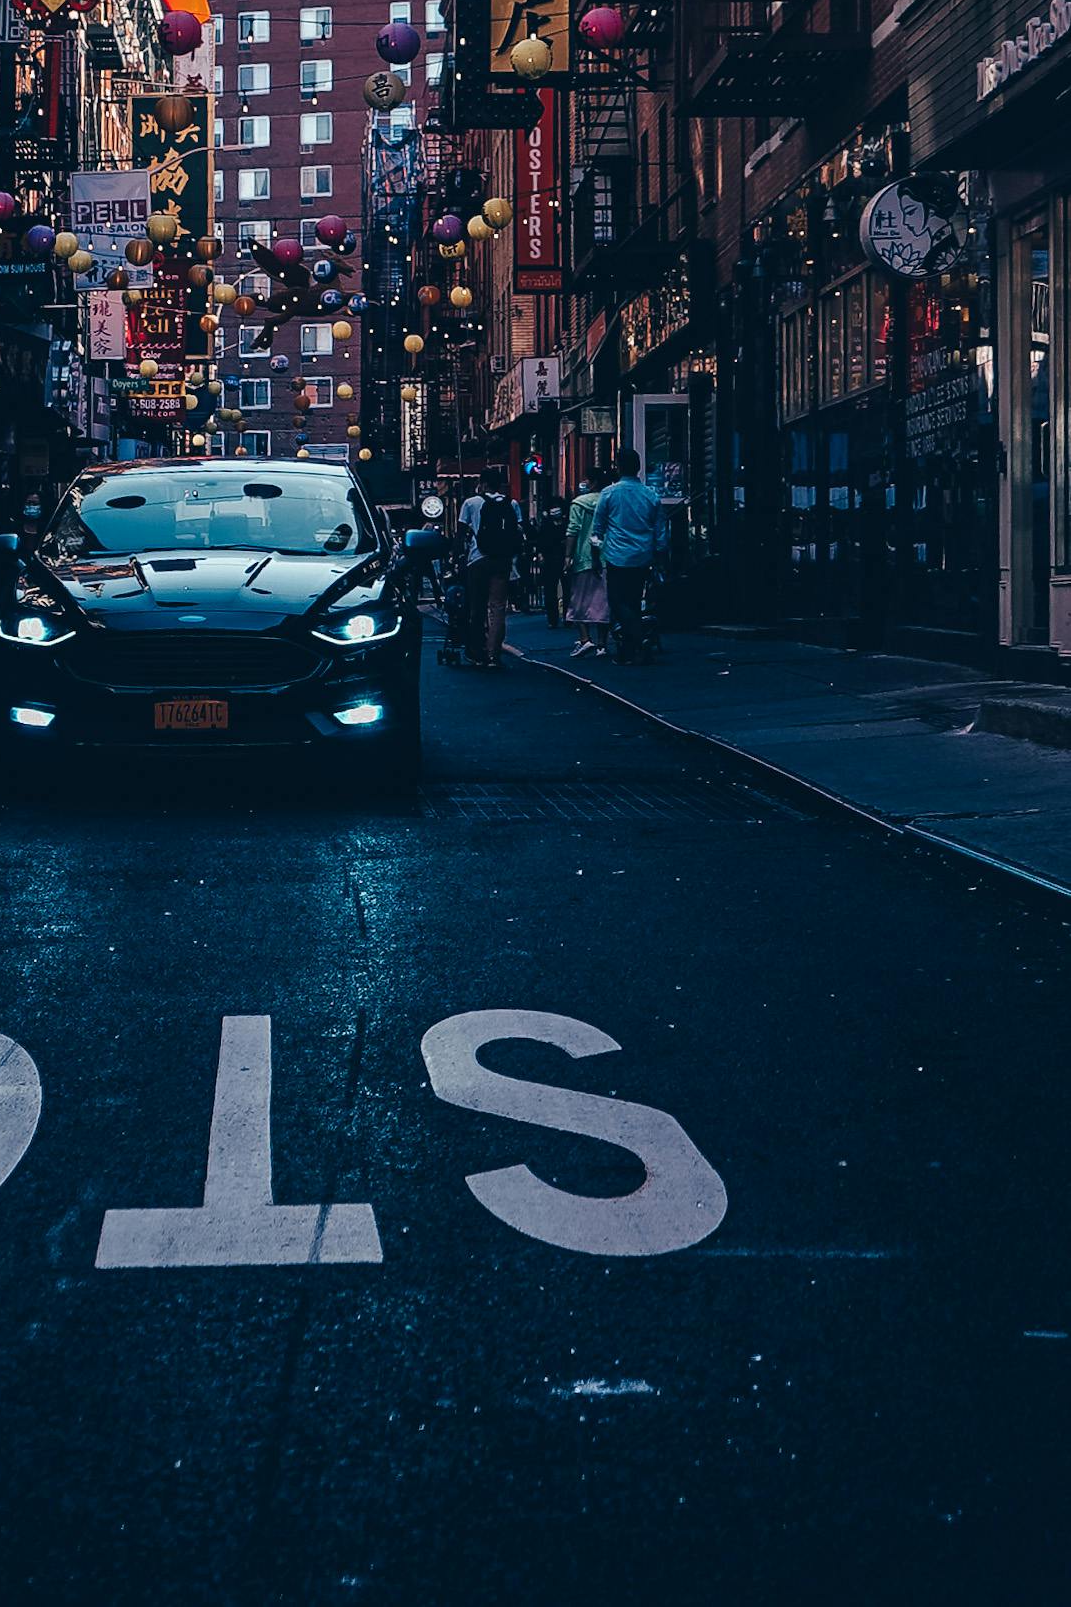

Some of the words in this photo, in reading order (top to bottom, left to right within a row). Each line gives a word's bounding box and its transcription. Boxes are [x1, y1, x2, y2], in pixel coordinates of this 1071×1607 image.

[372, 75, 393, 98] 喜
[528, 91, 543, 259] OSTERS
[77, 200, 146, 223] PELL
[75, 224, 104, 235] HAIR
[110, 223, 147, 234] SALON
[92, 291, 113, 355] 瓏美容
[140, 350, 162, 360] Color
[112, 379, 139, 390] Doyers
